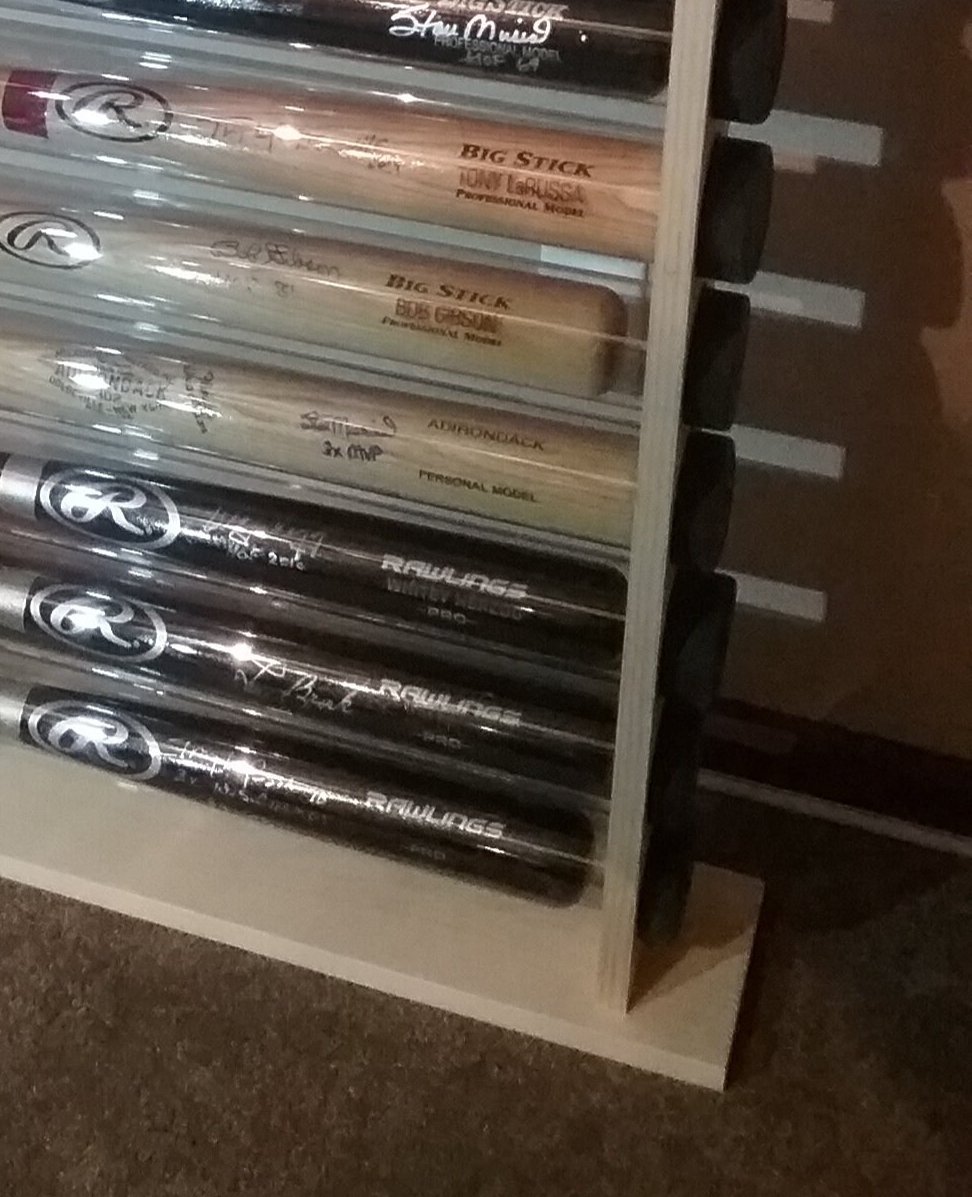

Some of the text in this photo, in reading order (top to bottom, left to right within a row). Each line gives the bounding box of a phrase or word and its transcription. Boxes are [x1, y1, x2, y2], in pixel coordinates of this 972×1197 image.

[460, 143, 595, 178] BIG STICK
[455, 188, 538, 211] PROFESSIONAL
[385, 273, 512, 310] BIG STICK
[427, 418, 545, 452] ADIRONDACK
[419, 469, 539, 504] PERSONAL MODEL
[380, 553, 529, 600] RAWLINGS
[379, 678, 523, 728] RAWLINGS
[364, 790, 507, 840] RAWLINGS
